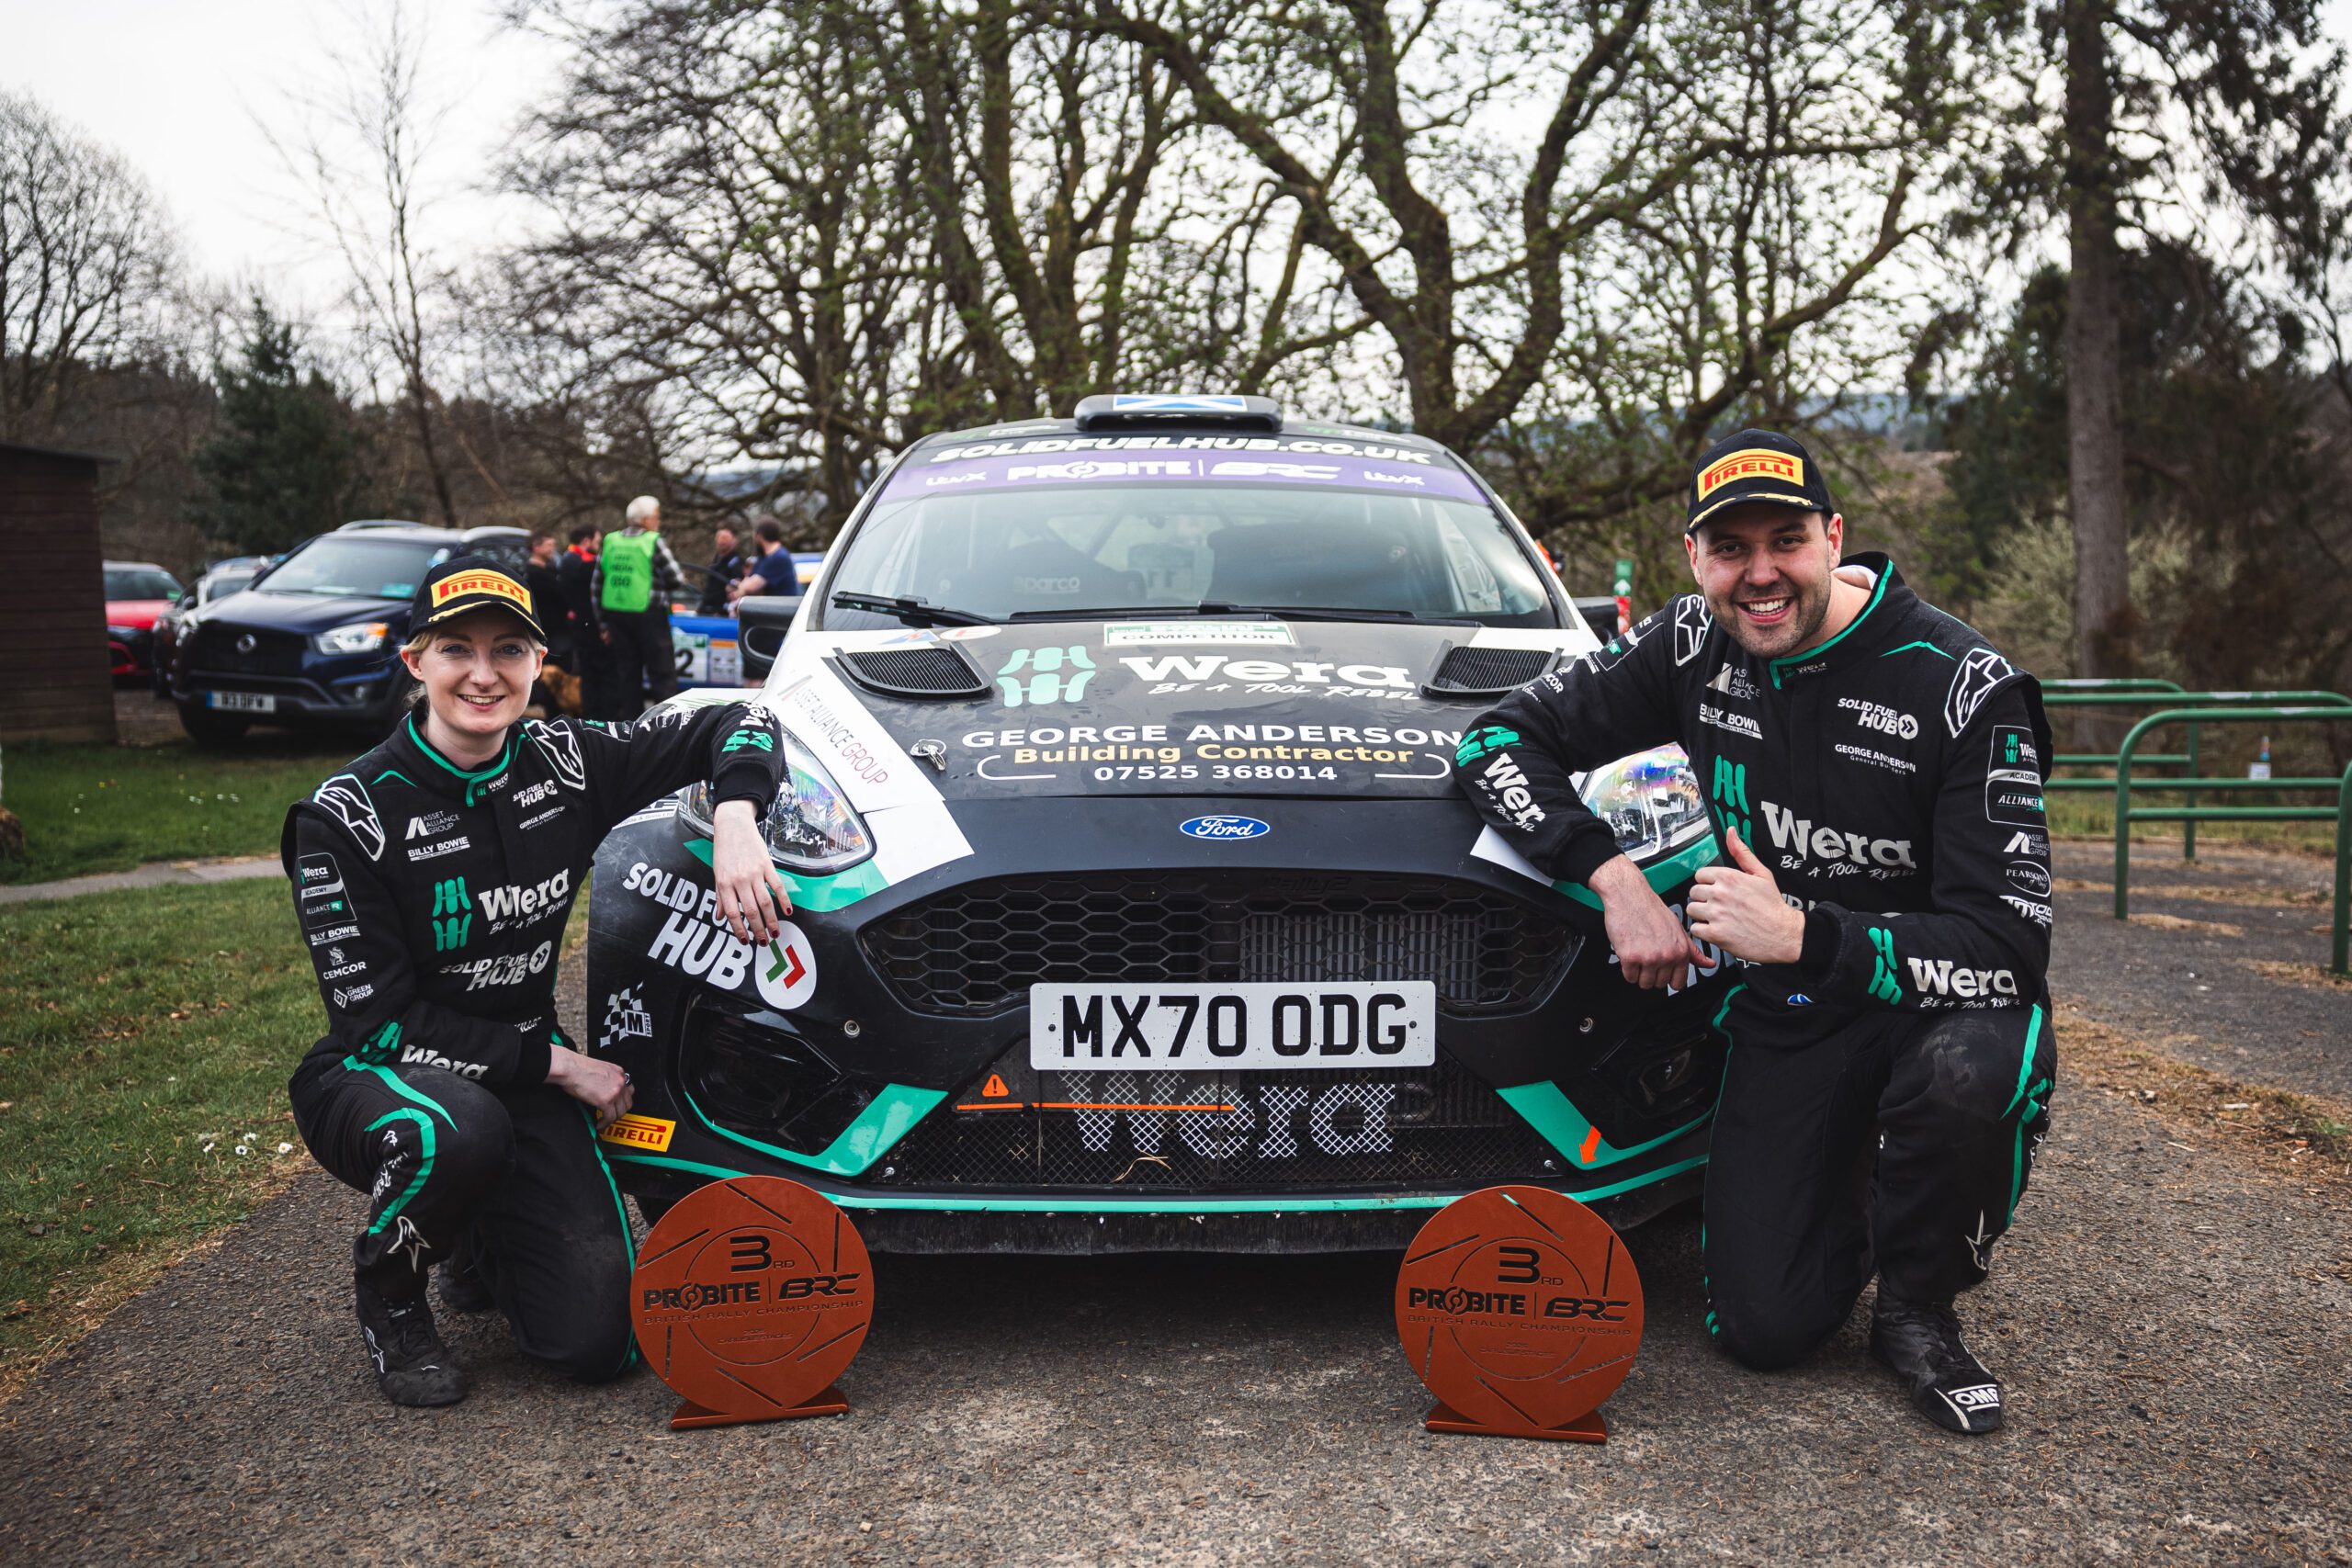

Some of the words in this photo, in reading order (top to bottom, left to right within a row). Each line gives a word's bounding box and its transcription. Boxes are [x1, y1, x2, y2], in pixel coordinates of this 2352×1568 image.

[930, 437, 1431, 464] SOLIDFUELHUB.CO.UK
[1008, 461, 1192, 480] PROBITE
[1704, 454, 1794, 492] PIRELLI
[438, 571, 526, 604] PIRELLI
[1118, 655, 1417, 689] Wera
[1148, 683, 1200, 694] BE
[1245, 682, 1311, 694] TOOL
[1323, 685, 1420, 700] REBEL
[1838, 697, 1873, 712] SOLID
[1873, 704, 1898, 720] FUEL
[1858, 711, 1898, 735] HUB
[962, 725, 1168, 748] GEORGE
[1185, 724, 1462, 747] ANDERSON
[1014, 745, 1181, 764] Building
[1196, 743, 1414, 763] Contractor
[1835, 743, 1871, 759] GEORGE
[1849, 754, 1877, 766] General
[842, 742, 888, 784] GROUP
[1094, 765, 1199, 781] 07525
[1212, 765, 1338, 780] 368014
[521, 788, 545, 808] HUB
[1998, 795, 2039, 807] ALLIANCE
[423, 810, 444, 822] ASSET
[426, 814, 460, 828] ALLIANCE
[427, 822, 454, 835] GROUP
[1195, 818, 1254, 837] Ford
[1760, 800, 1917, 870] Wera
[407, 845, 434, 858] BILLY
[436, 836, 469, 852] BOWIE
[1781, 855, 1804, 870] BE
[1808, 869, 1821, 878] A
[1827, 862, 1862, 878] TOOL
[478, 867, 570, 922] Wera
[622, 862, 698, 913] SOLID
[328, 925, 359, 938] BOWIE
[647, 911, 753, 990] HUB
[322, 961, 368, 980] CEMCOR
[439, 958, 492, 974] SOLID
[1907, 956, 2018, 998] Wera
[347, 984, 372, 997] GREEN
[349, 989, 374, 1002] GROUP
[627, 1013, 644, 1034] M
[1062, 995, 1247, 1058] MX70
[1272, 993, 1407, 1056] ODG
[1057, 1070, 1396, 1159] Wera
[644, 1280, 762, 1312] PROBITE
[778, 1272, 862, 1300] BRC
[643, 1313, 701, 1325] BRITISH
[706, 1308, 752, 1320] RALLY
[756, 1300, 865, 1316] CHAMPIONSHIP
[1408, 1285, 1526, 1316] PROBITE
[1544, 1296, 1632, 1323] BRC
[1408, 1314, 1464, 1325] BRITISH
[1470, 1319, 1514, 1330] RALLY
[1521, 1323, 1632, 1337] CHAMPIONSHIP
[1954, 1387, 1999, 1406] OMP
